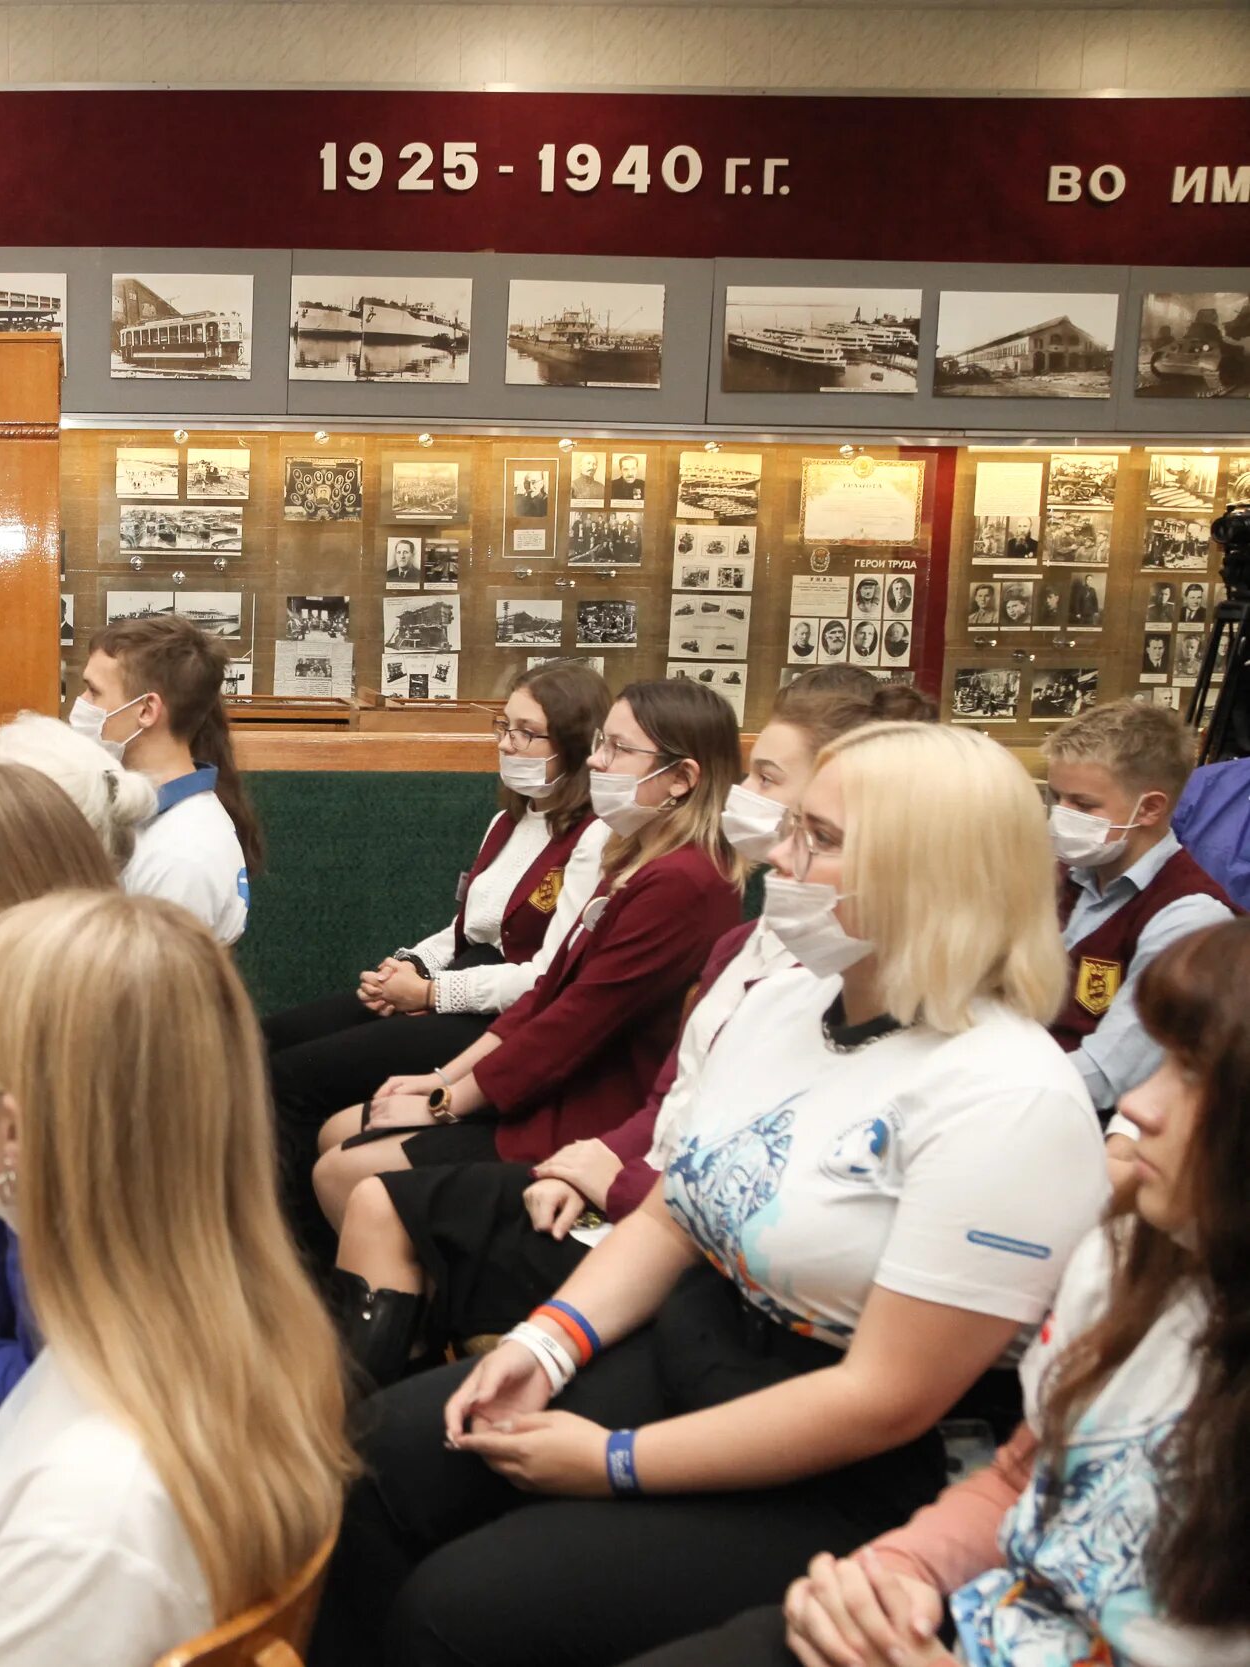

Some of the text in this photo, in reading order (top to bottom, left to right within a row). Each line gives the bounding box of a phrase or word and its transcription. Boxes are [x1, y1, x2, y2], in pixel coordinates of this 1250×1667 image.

[320, 142, 478, 191] 1925
[498, 165, 514, 173] -
[538, 143, 702, 194] 1940
[1047, 164, 1126, 202] ВО
[854, 559, 917, 569] ГЕРОИ ТРУДА
